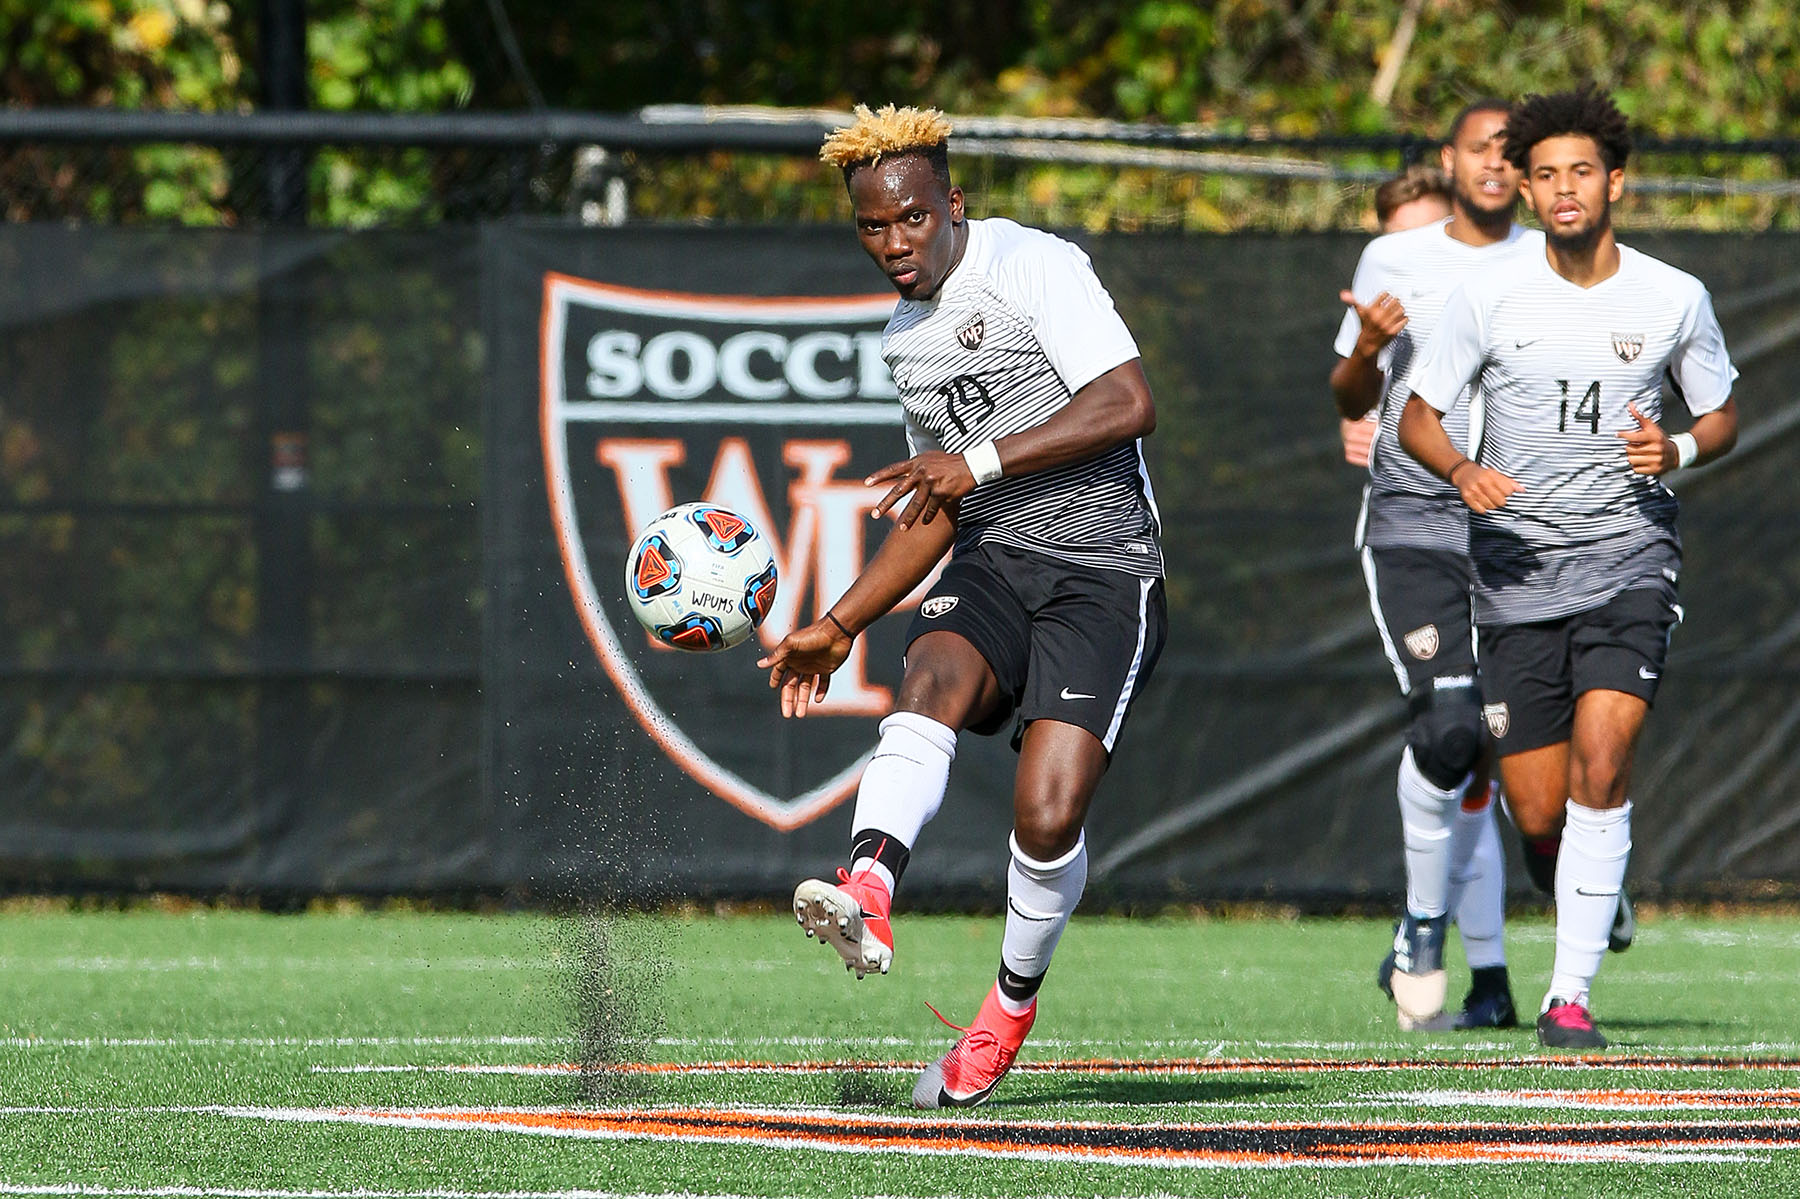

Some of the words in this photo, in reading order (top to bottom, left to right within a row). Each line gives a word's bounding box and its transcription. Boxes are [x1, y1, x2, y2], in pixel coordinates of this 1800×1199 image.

[959, 325, 982, 346] WP
[1615, 341, 1641, 360] WP
[938, 374, 996, 436] 19
[1554, 379, 1601, 434] 14
[691, 590, 734, 615] WPUMS
[925, 602, 951, 614] WP
